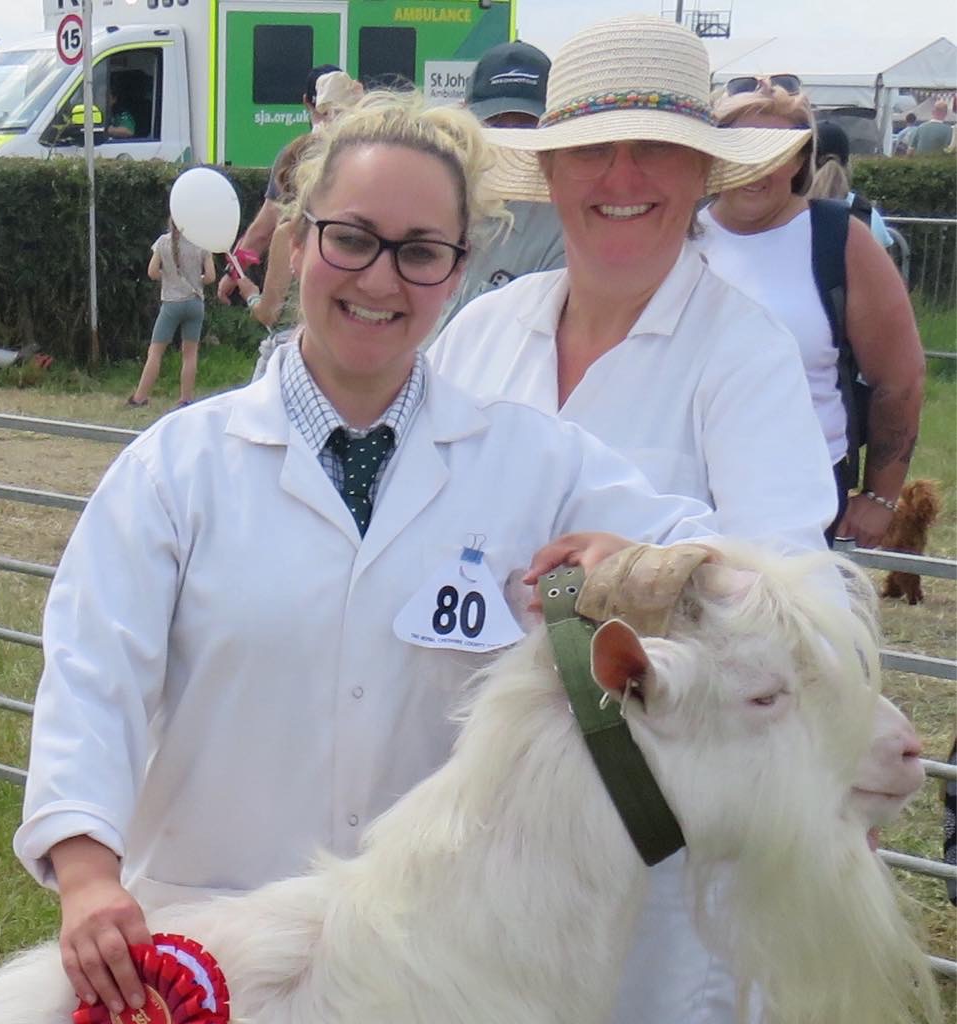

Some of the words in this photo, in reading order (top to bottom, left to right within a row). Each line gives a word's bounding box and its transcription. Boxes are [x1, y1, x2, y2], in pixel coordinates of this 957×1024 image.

[394, 7, 471, 22] AMBULANCE
[61, 28, 81, 50] 15
[430, 73, 442, 87] St
[254, 110, 310, 126] sja.org.uk
[432, 585, 486, 639] 80
